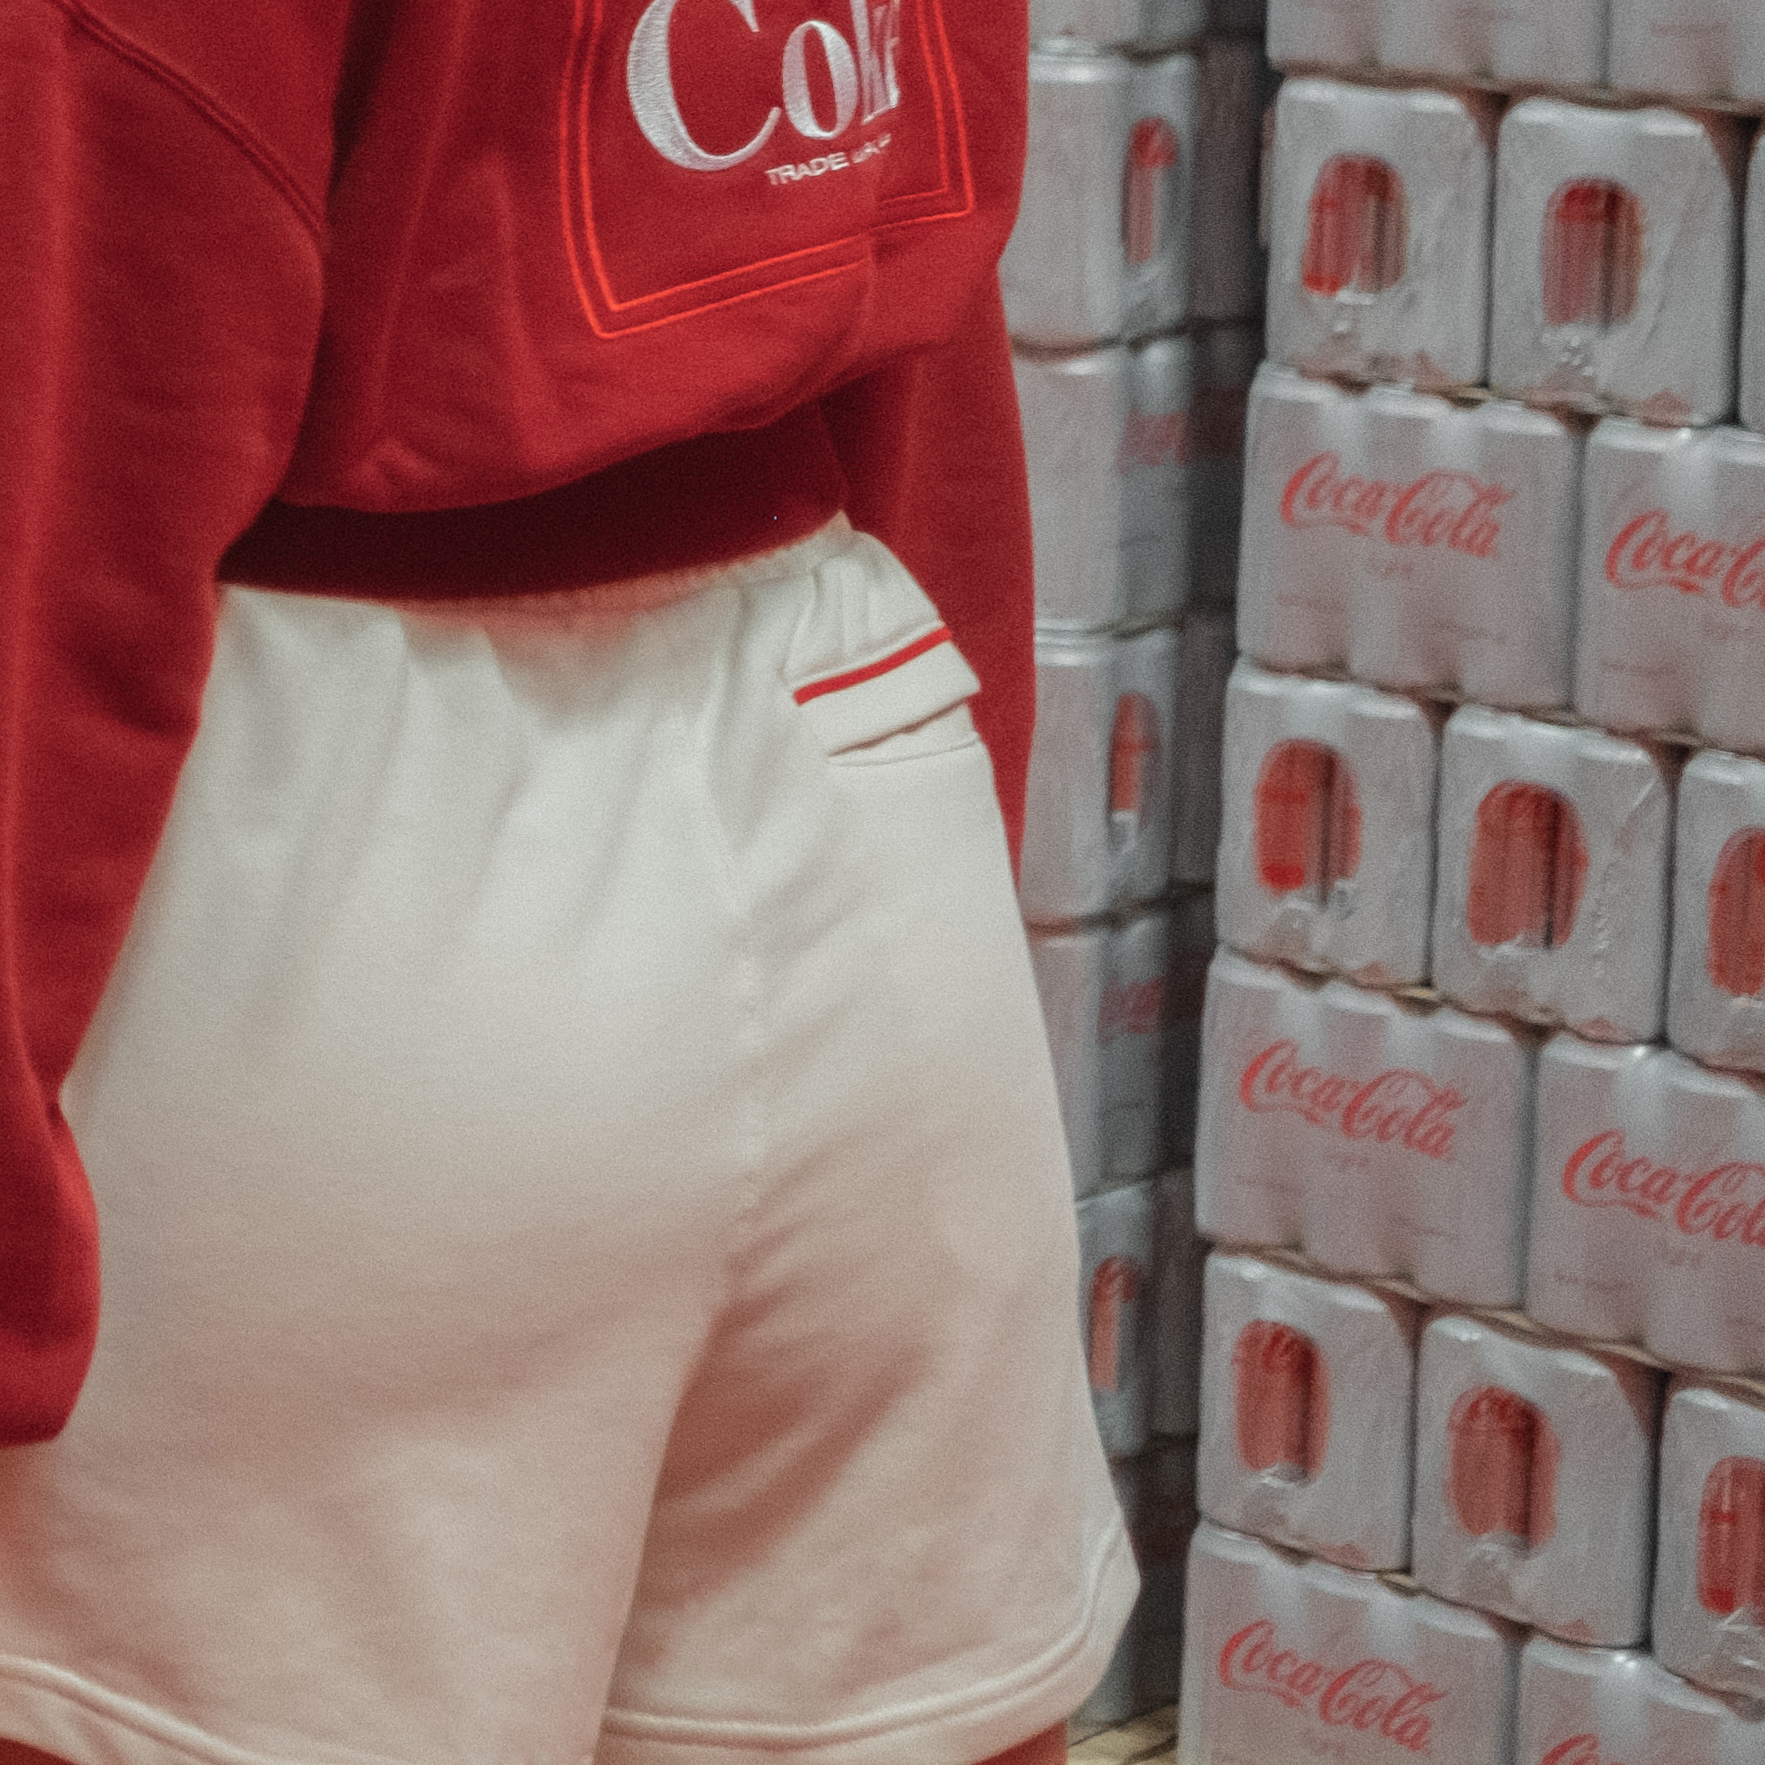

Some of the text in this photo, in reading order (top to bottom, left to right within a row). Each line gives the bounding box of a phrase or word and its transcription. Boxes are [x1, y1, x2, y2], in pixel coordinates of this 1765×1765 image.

[765, 151, 850, 186] TRADE
[1278, 449, 1515, 560] Coca-Cola
[1239, 1038, 1468, 1162] Coca-Cola
[1218, 1617, 1449, 1757] Coca-Cola
